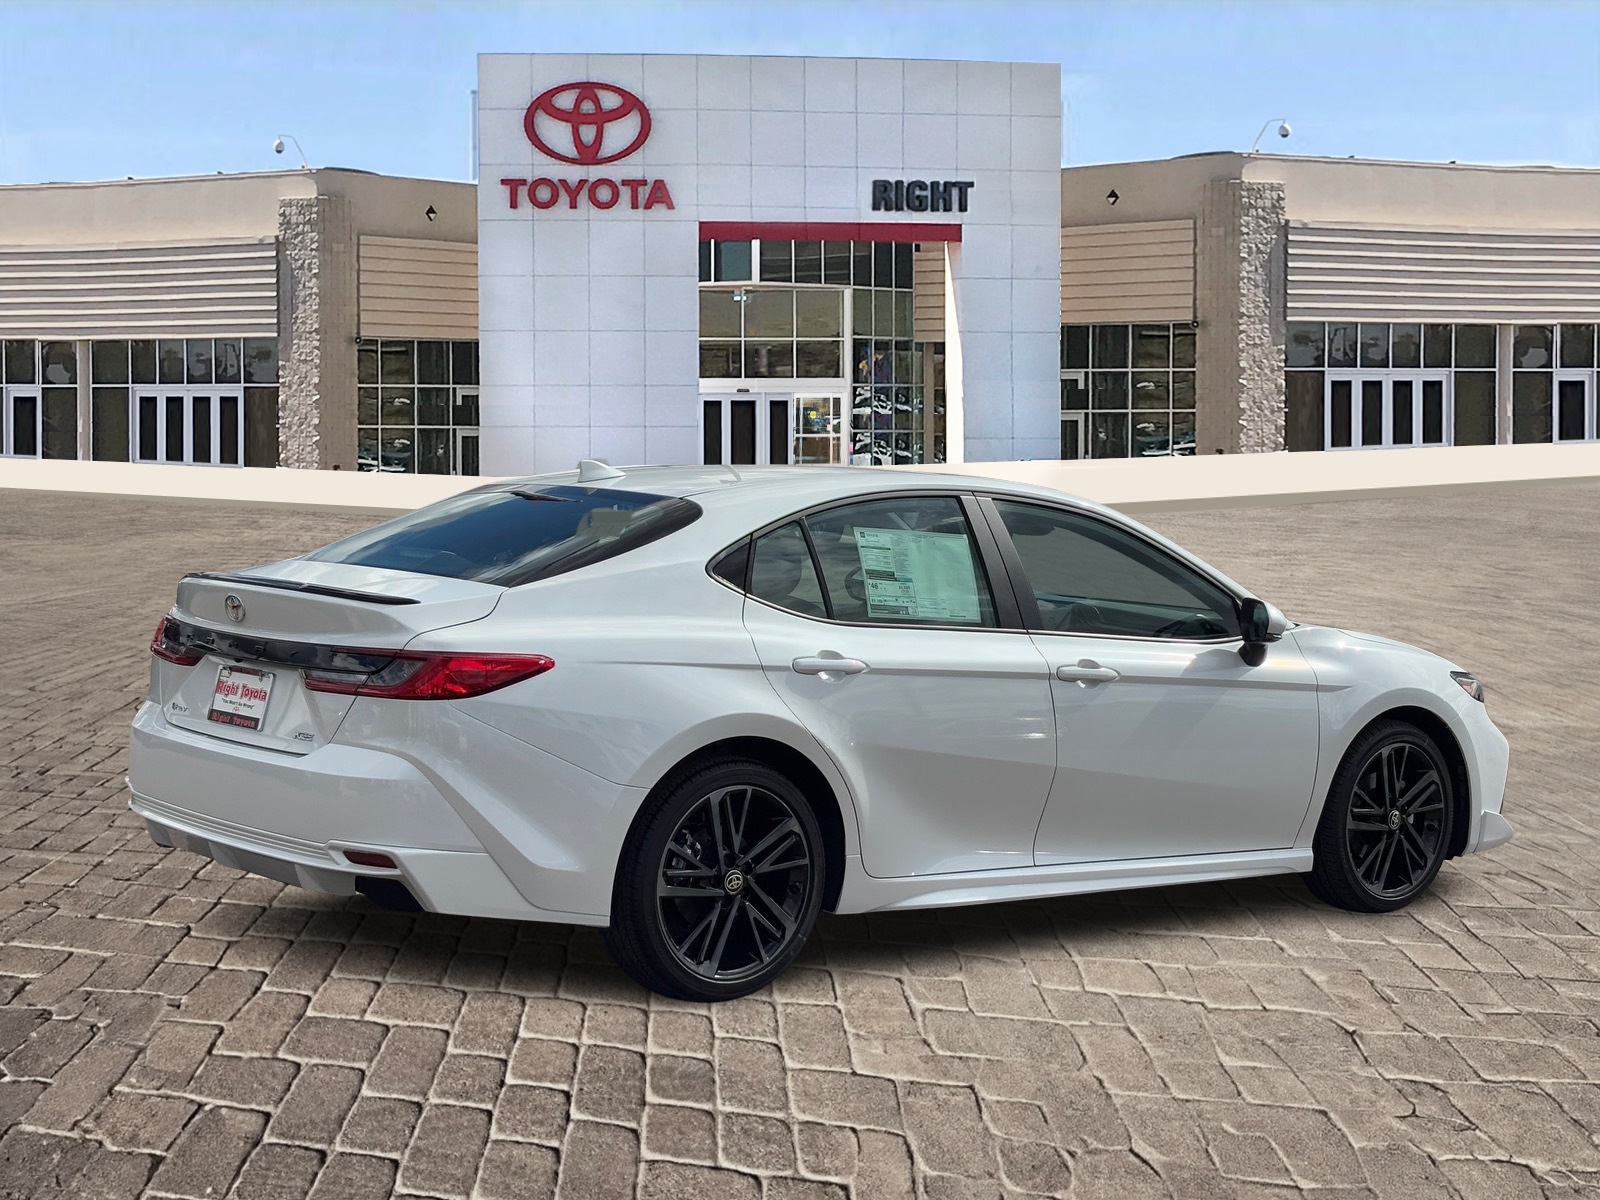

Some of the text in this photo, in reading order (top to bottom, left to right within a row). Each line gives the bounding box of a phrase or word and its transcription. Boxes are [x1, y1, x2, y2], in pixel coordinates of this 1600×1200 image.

[500, 177, 675, 210] TOYOTA
[872, 179, 974, 212] RIGHT
[216, 679, 268, 702] Right Toyota
[211, 711, 257, 727] Right Toyota
